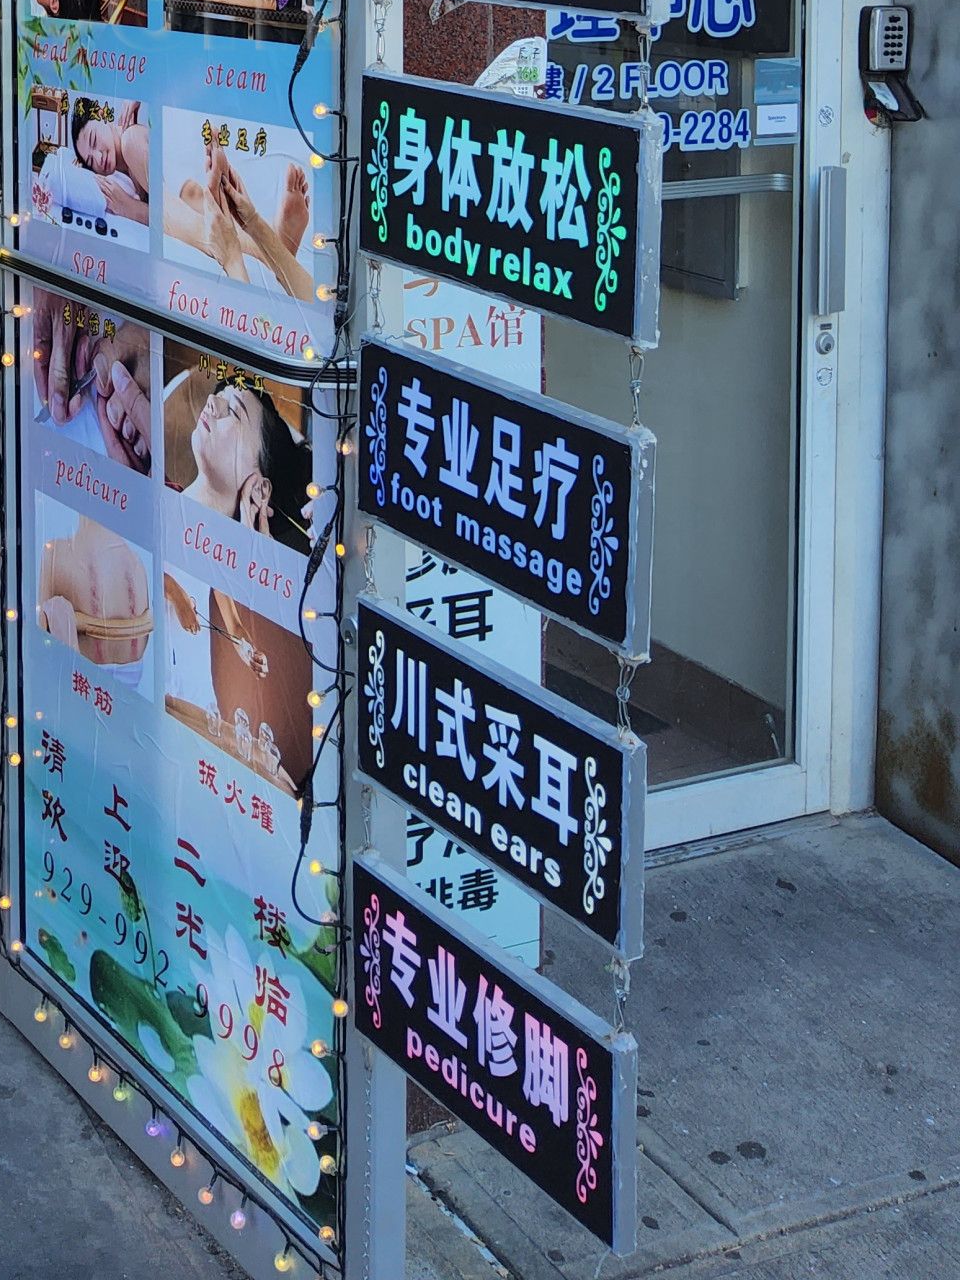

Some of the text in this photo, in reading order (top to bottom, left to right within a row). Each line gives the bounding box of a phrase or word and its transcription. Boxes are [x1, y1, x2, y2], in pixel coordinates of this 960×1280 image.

[33, 34, 147, 82] head massage
[205, 63, 267, 92] steam
[201, 119, 268, 157] 专业足疗
[393, 107, 592, 249] 身体放松
[73, 251, 108, 284] SPA
[406, 214, 481, 276] body
[490, 250, 573, 300] relax
[169, 281, 311, 356] foot massage
[406, 304, 526, 351] SPA馆
[198, 353, 266, 398] 川式采耳
[56, 457, 128, 511] pedicure
[397, 377, 580, 542] 专业足疗
[184, 523, 296, 599] clean ears
[391, 471, 583, 596] foot massage
[391, 648, 579, 848] 川式采耳
[199, 759, 274, 834] 拔火罐
[403, 760, 482, 835] clean
[491, 821, 562, 888] ears
[383, 912, 569, 1128] 专业修脚
[406, 1025, 537, 1155] pedicure
